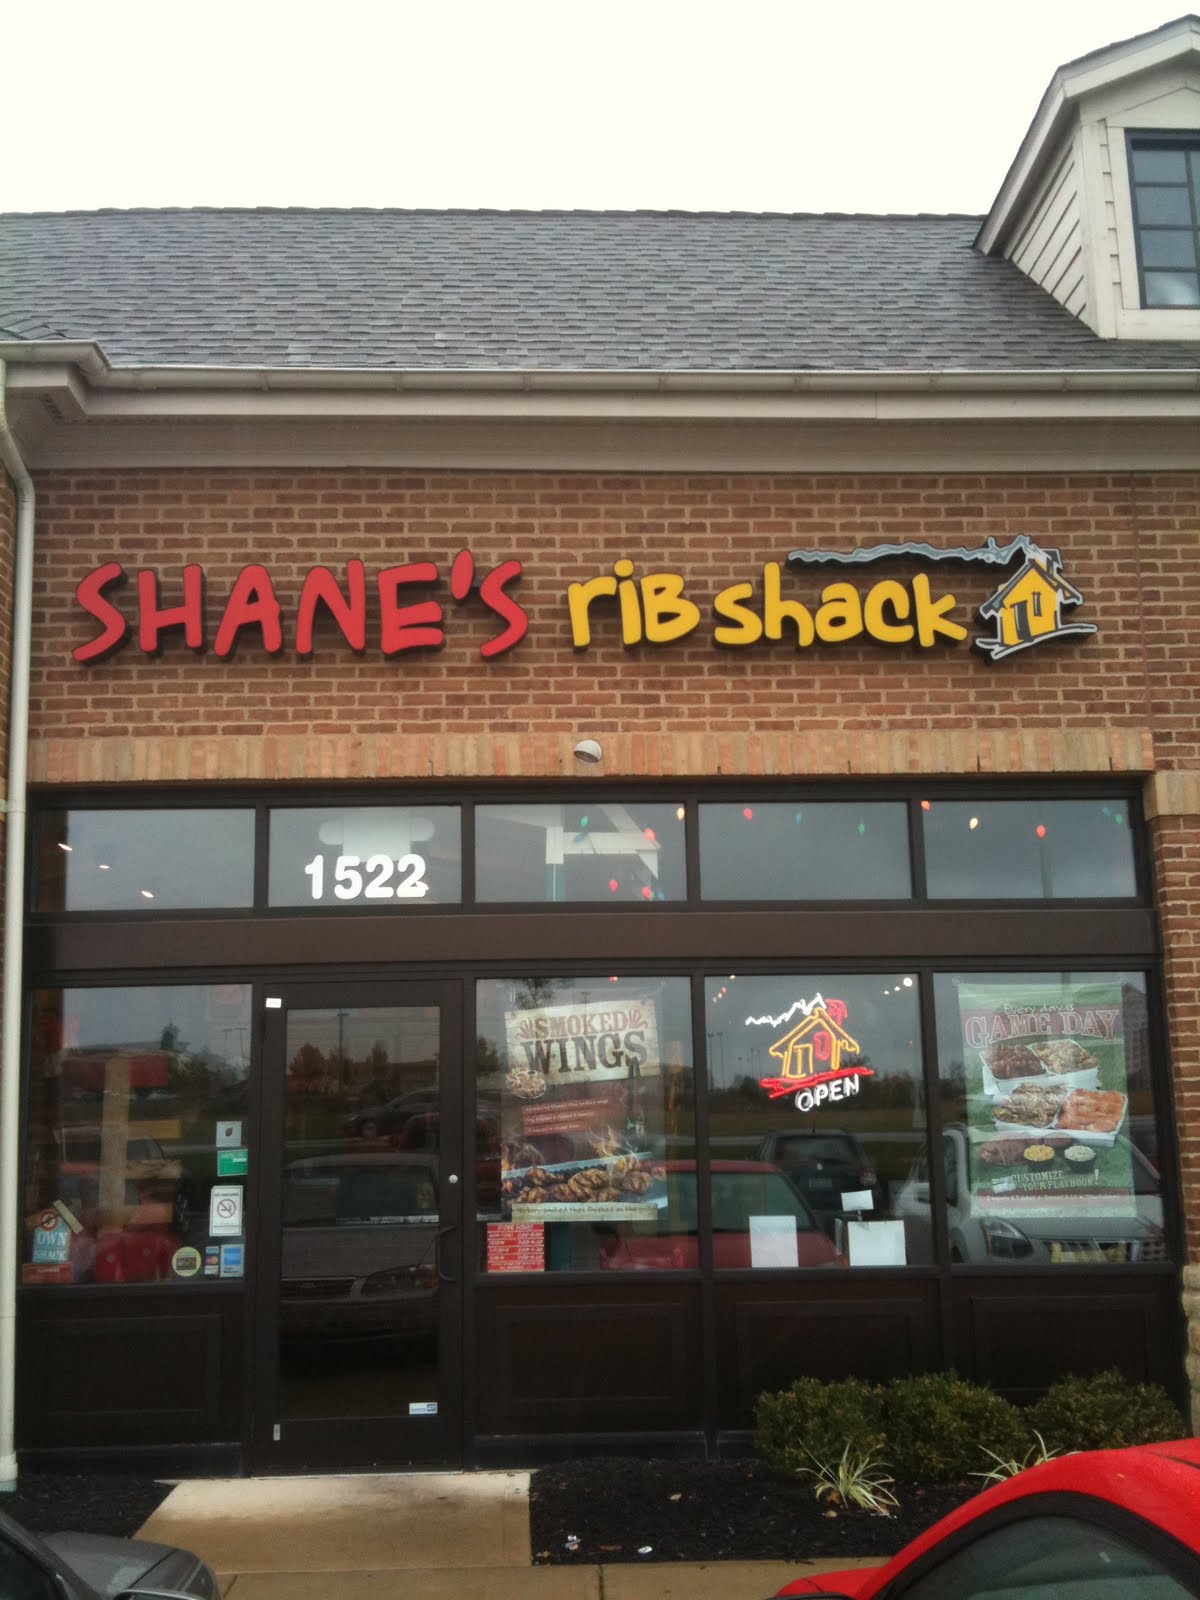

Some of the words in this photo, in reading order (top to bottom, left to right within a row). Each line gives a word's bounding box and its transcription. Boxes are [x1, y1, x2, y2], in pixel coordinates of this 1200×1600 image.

[72, 548, 528, 662] SHANE'S
[304, 854, 427, 899] 1522
[534, 1010, 628, 1039] SMOKED
[965, 1012, 1051, 1048] GAME
[1060, 1010, 1119, 1042] DAY
[520, 1031, 648, 1074] WINGS
[795, 1073, 860, 1112] OPEN
[1011, 1170, 1064, 1182] CUSTOMIZE
[1022, 1181, 1047, 1191] YOUR
